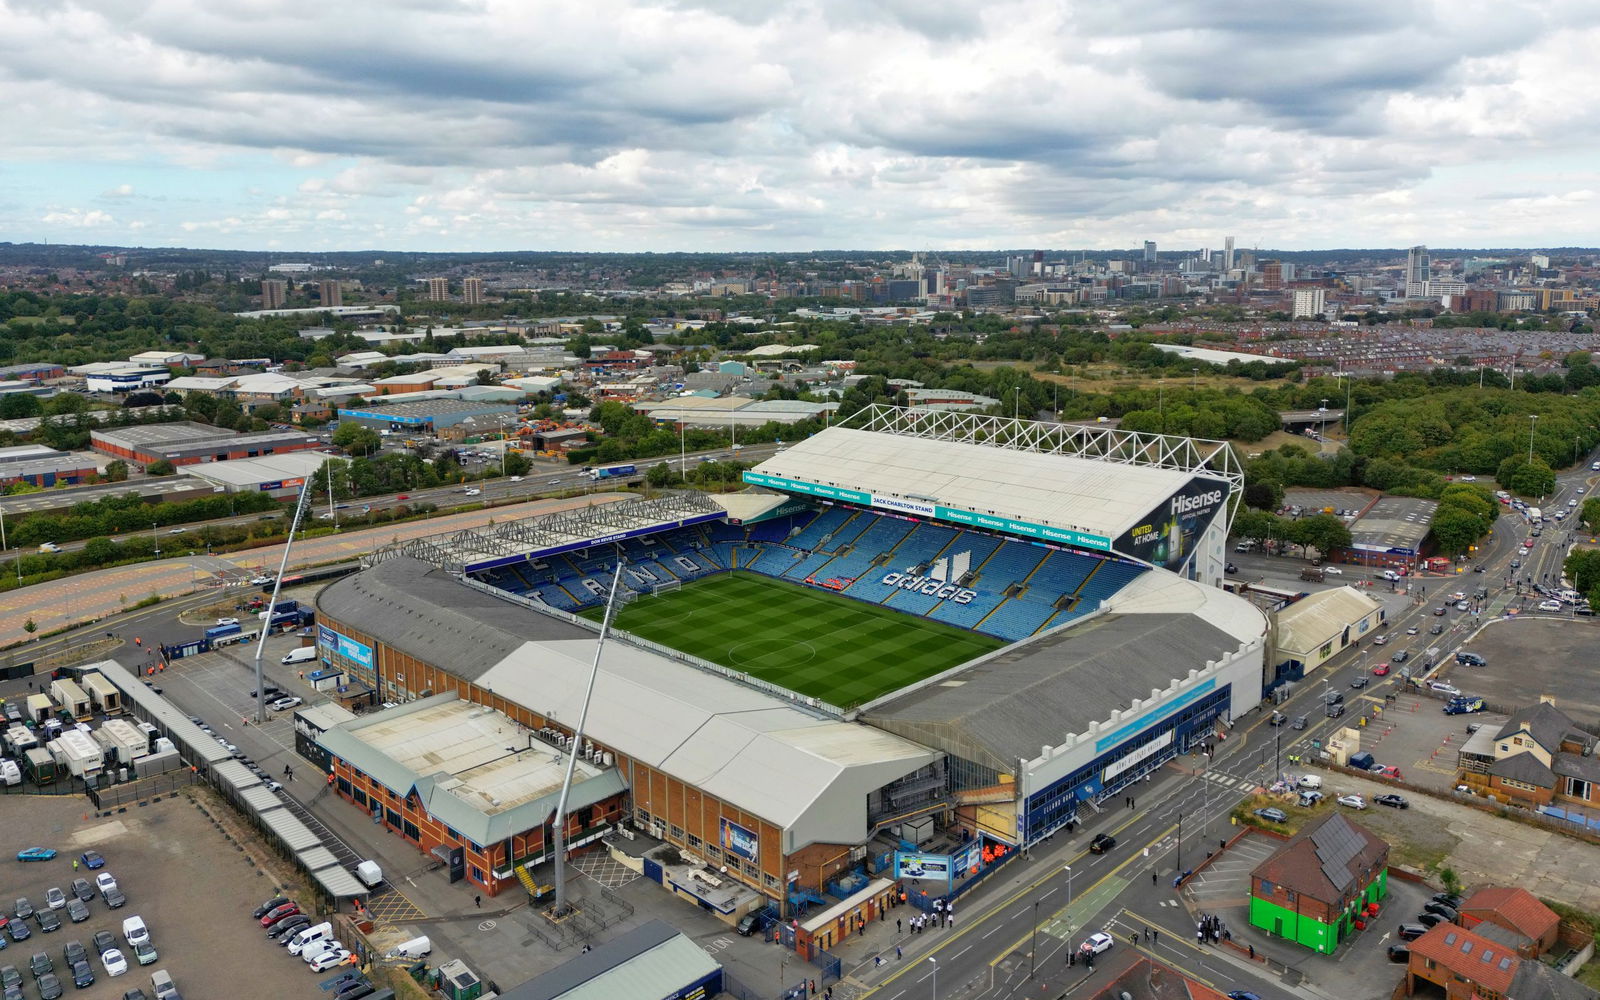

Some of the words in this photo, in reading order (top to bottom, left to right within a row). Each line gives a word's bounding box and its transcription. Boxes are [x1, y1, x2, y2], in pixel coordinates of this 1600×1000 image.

[746, 475, 764, 483] Hisense
[768, 478, 787, 487] Hisense
[791, 482, 810, 491] Hisense
[814, 486, 835, 496] Hisense
[839, 491, 860, 500] Hisense
[873, 497, 887, 505] JACK
[887, 500, 915, 510] CHARLTON
[915, 505, 933, 514] STAND
[1171, 490, 1222, 515] Hisense
[776, 504, 806, 516] Hisense
[947, 511, 973, 521] Hisense
[977, 516, 1004, 527] Hisense
[1009, 522, 1037, 534] Hisense
[1131, 524, 1152, 537] UNITED
[1042, 529, 1072, 540] Hisense
[1134, 535, 1143, 546] AT
[1142, 531, 1159, 544] HOME
[1077, 536, 1108, 548] Hisense
[882, 572, 977, 605] adidas
[1043, 799, 1061, 815] ELLAND
[1062, 791, 1074, 803] ROAD
